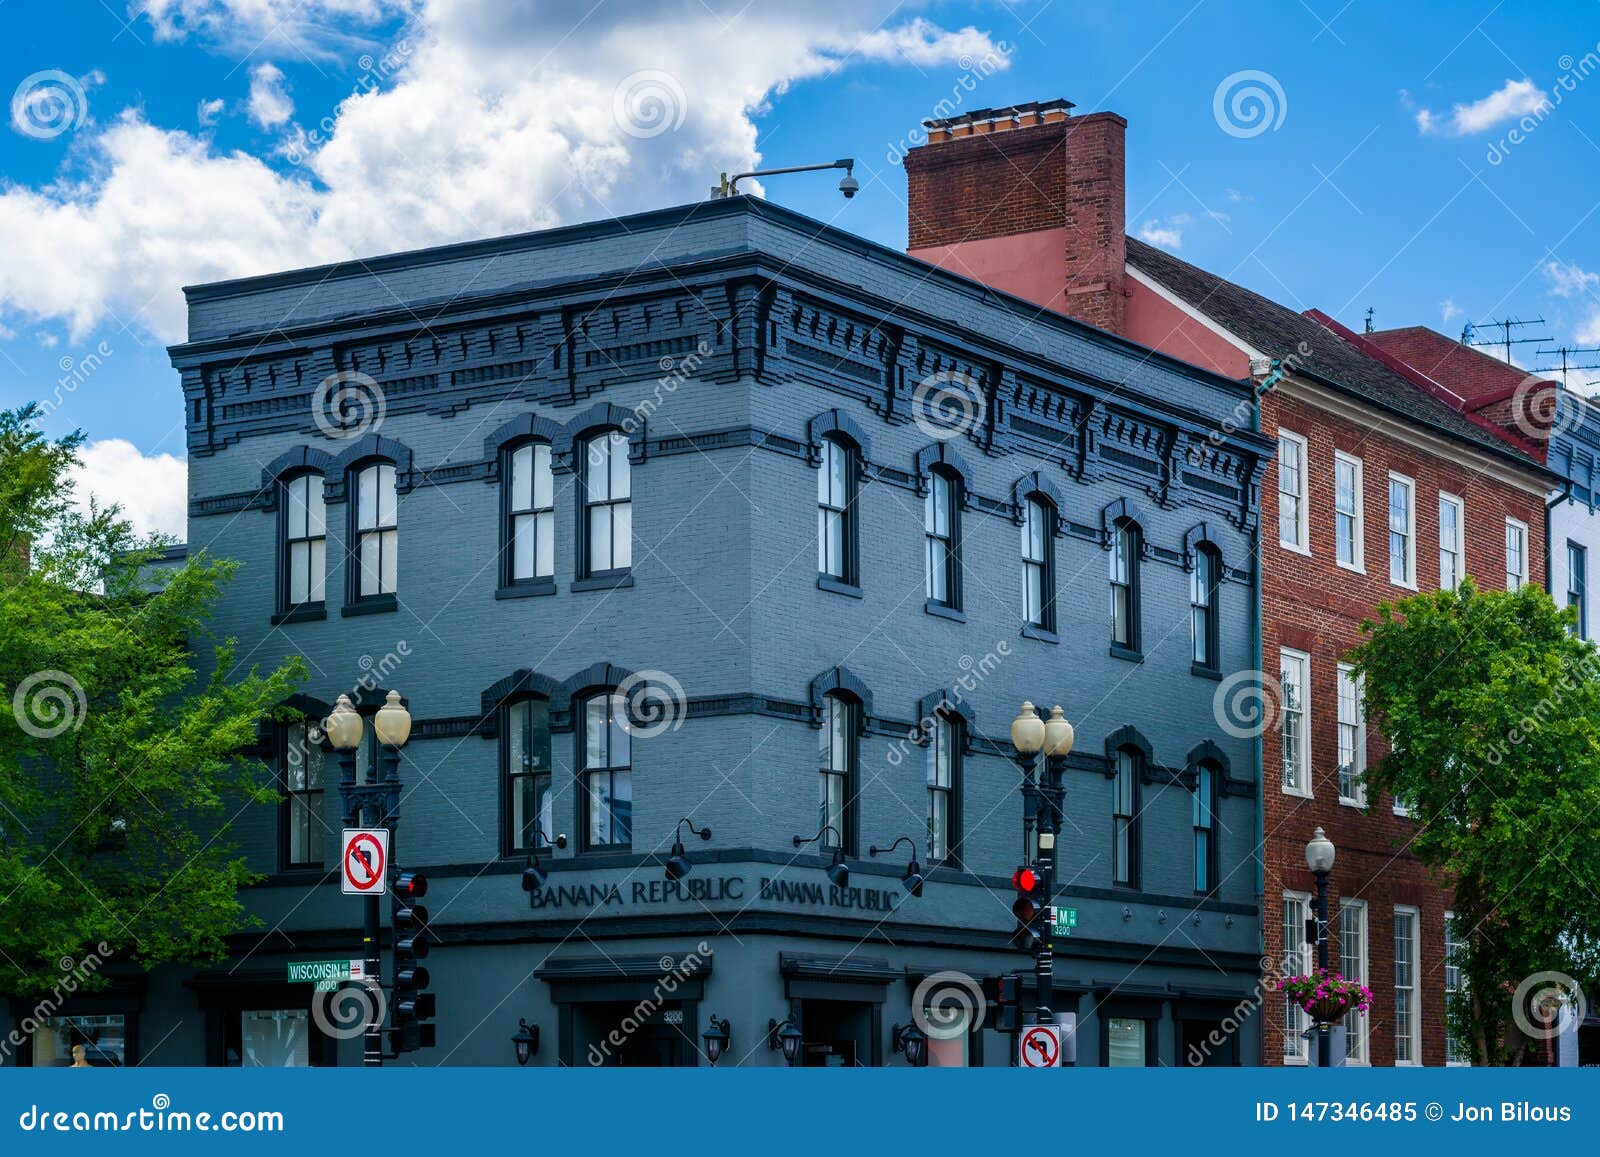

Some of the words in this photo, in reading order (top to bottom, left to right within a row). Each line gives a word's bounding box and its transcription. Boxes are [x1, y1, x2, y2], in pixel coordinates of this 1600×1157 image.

[530, 879, 624, 909] BANANA
[632, 877, 744, 904] REPUBLIC
[760, 877, 825, 906] BANANA
[829, 884, 900, 912] REPUBLIC
[1060, 910, 1067, 924] M
[1055, 926, 1070, 936] 3200
[290, 963, 340, 980] WISCONSIN
[316, 981, 337, 991] 1000
[664, 1010, 683, 1022] 3200
